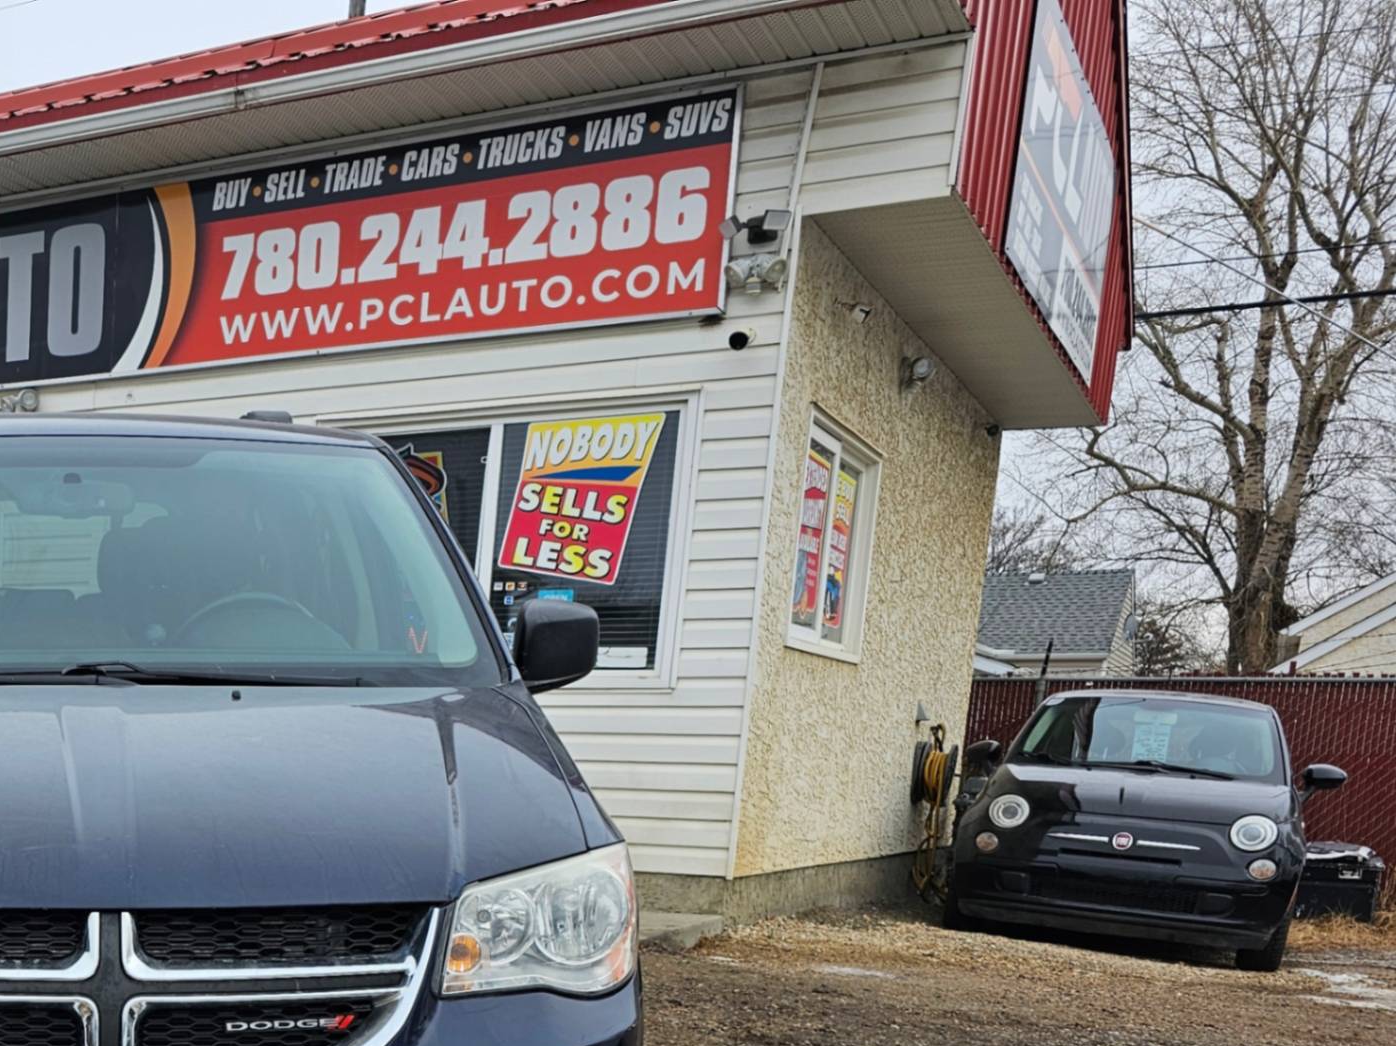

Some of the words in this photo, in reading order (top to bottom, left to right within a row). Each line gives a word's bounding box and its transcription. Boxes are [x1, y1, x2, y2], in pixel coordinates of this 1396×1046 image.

[212, 178, 252, 211] BUY
[264, 169, 306, 203] SELL
[324, 156, 387, 191] TRADE
[400, 144, 460, 181] CARS
[476, 126, 566, 170] TRUCKS
[583, 112, 646, 151] VANS
[664, 98, 733, 140] SUVS
[219, 166, 710, 300] 780.244.2886
[219, 258, 706, 345] WWW.PCLAUTO.COM
[524, 420, 660, 471] NOBODY
[518, 483, 628, 523] SELLS
[539, 519, 589, 541] FOR
[512, 537, 613, 578] LESS
[226, 1018, 340, 1031] DODGE
